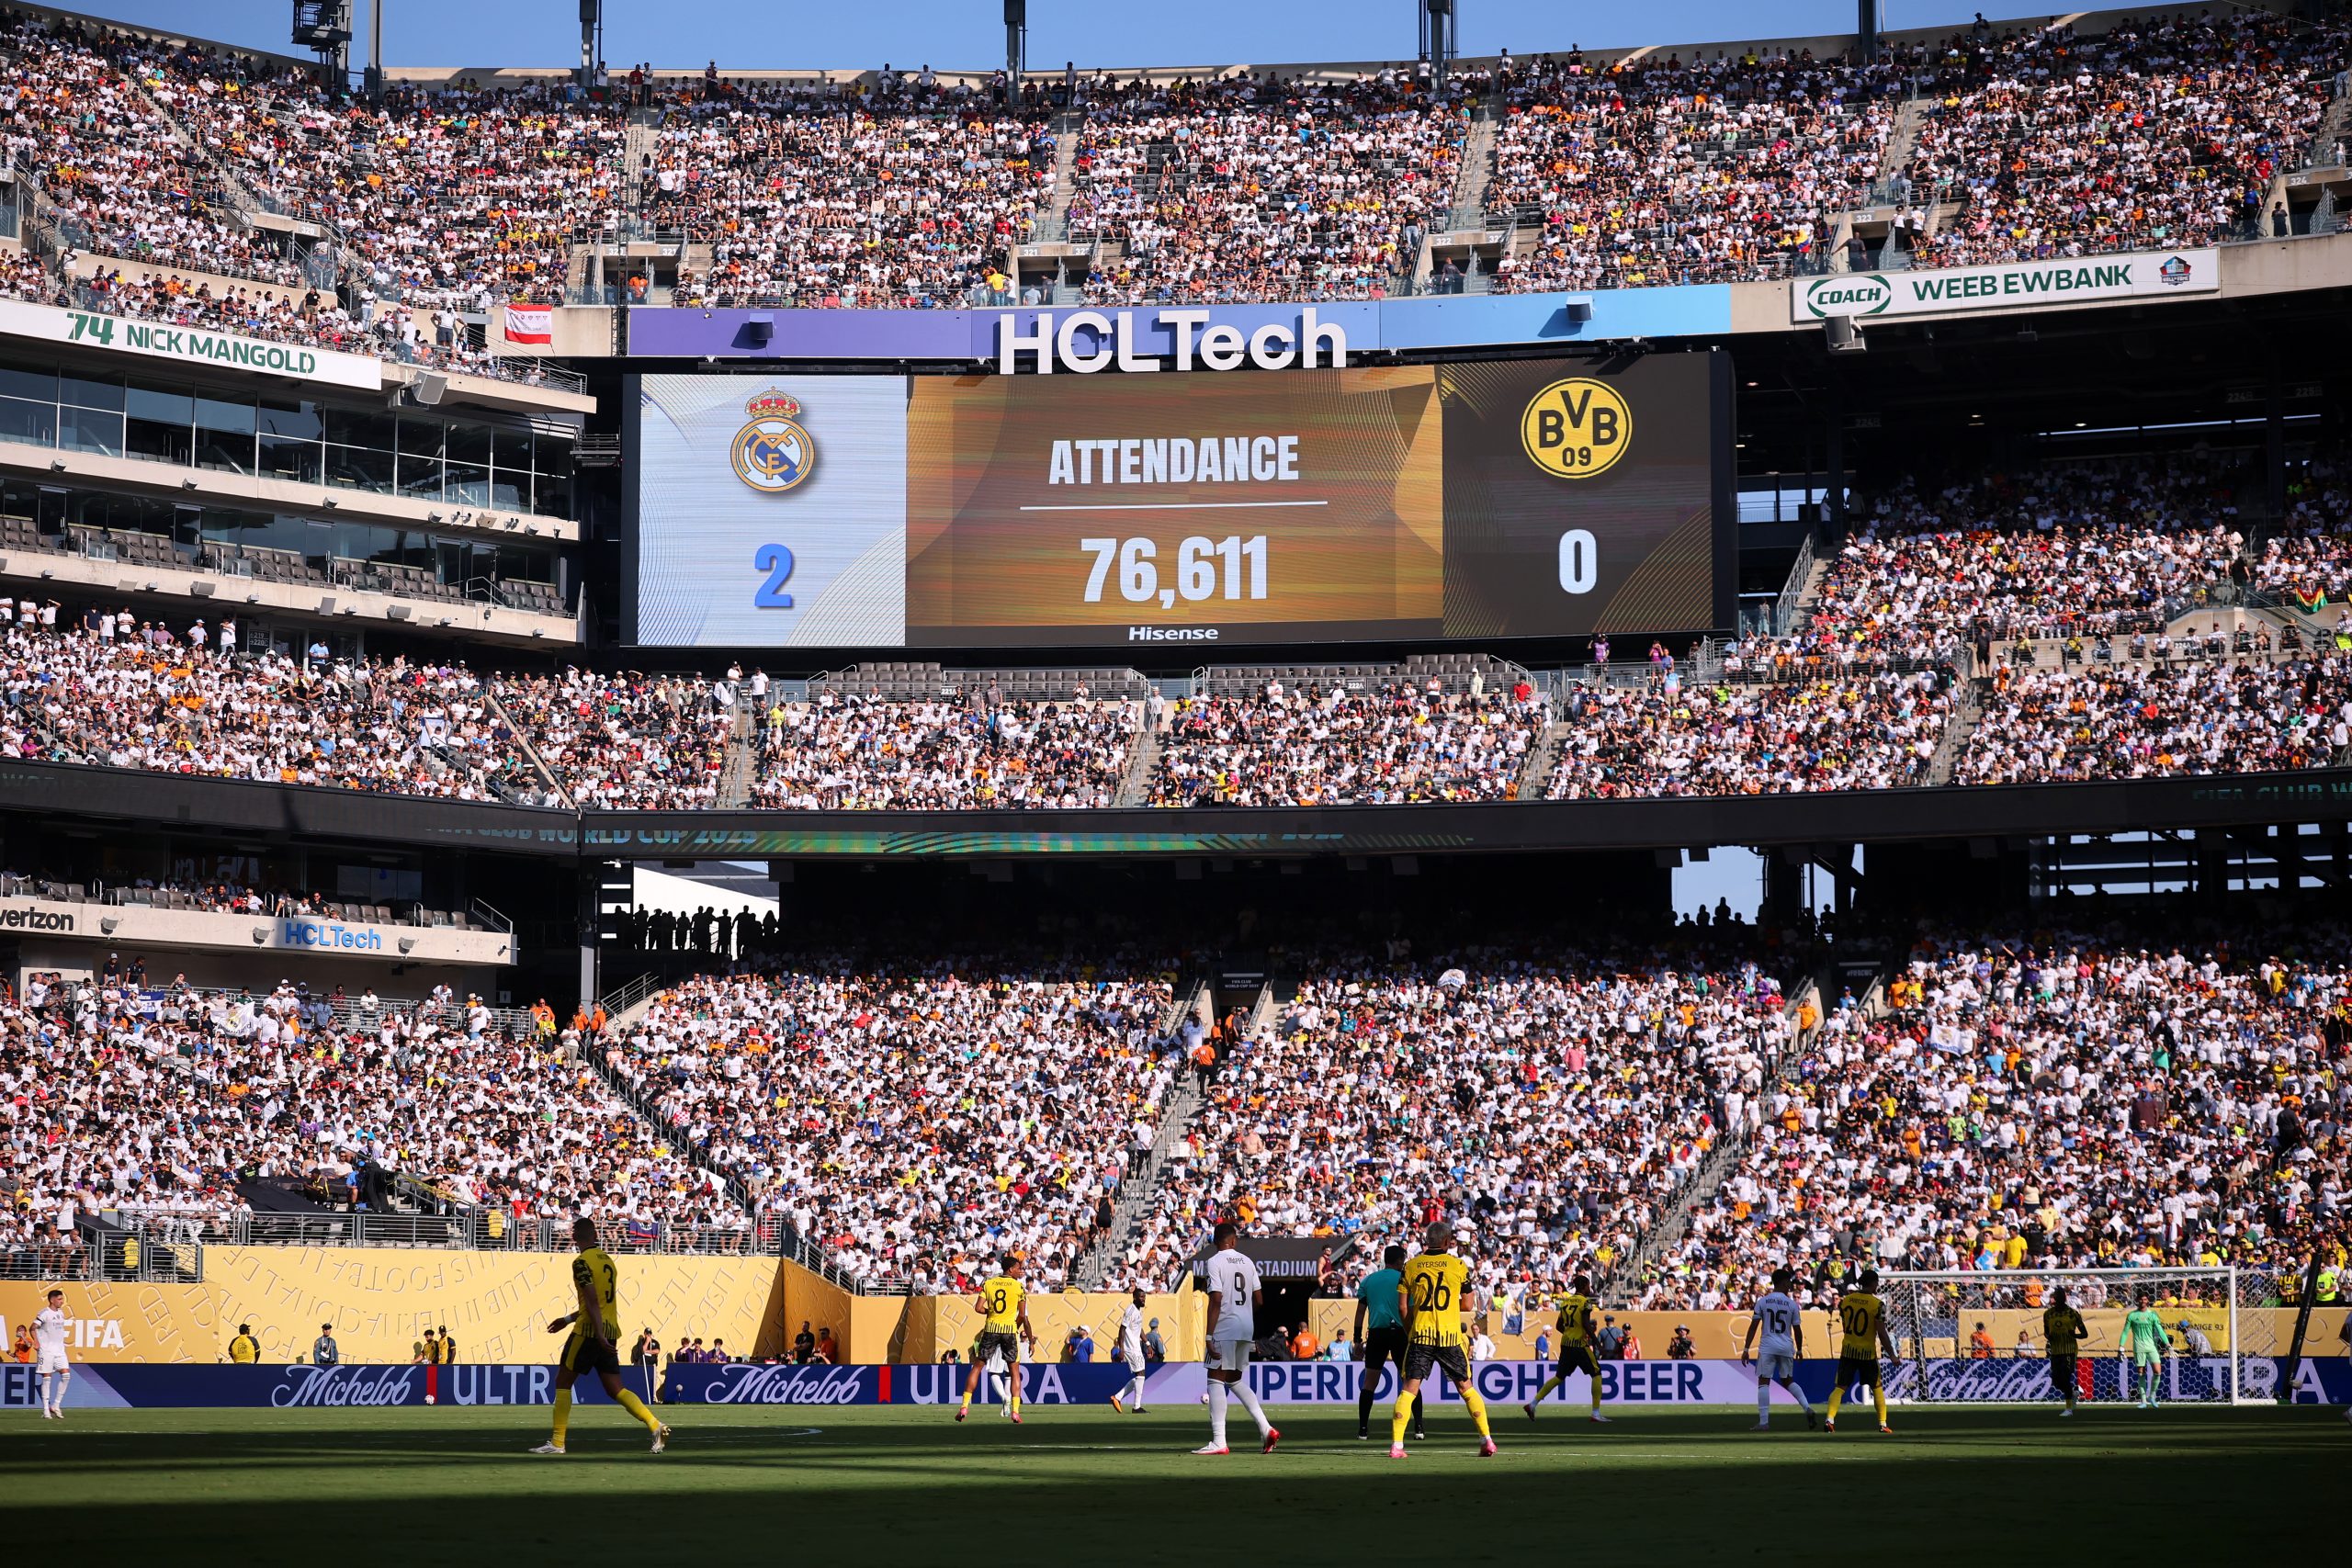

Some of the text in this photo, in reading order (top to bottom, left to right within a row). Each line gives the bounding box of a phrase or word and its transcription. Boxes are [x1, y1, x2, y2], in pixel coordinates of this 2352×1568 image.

[302, 226, 315, 235] 320
[1856, 214, 1873, 222] 323
[662, 247, 676, 255] 321
[1436, 237, 1451, 245] 322
[1816, 264, 2133, 304] COACH WEEB EWBANK
[66, 311, 317, 375] 74 NICK MANGOLD
[999, 308, 1347, 375] HCLTech
[1538, 389, 1619, 449] BVB
[1048, 435, 1299, 485] ATTENDANCE
[1561, 446, 1592, 468] 09
[753, 543, 794, 609] 2
[1080, 536, 1269, 609] 76,611
[1559, 529, 1598, 595] 0
[1127, 626, 1219, 642] Hisense
[637, 830, 689, 844] CUP
[0, 906, 74, 931] verizon
[285, 921, 381, 950] HCLTech
[1255, 1259, 1317, 1277] STADIUM
[1417, 1260, 1448, 1269] RYERSON
[603, 1263, 615, 1303] 3
[1234, 1271, 1247, 1306] 9
[1415, 1271, 1451, 1312] 26
[993, 1289, 1007, 1314] 8
[1562, 1304, 1578, 1328] 17
[1766, 1308, 1787, 1334] 15
[1844, 1305, 1869, 1337] 20
[3, 1366, 50, 1405] ER
[272, 1365, 417, 1408] Michelob
[705, 1365, 867, 1405] Michelob
[1599, 1363, 1705, 1402] BEER
